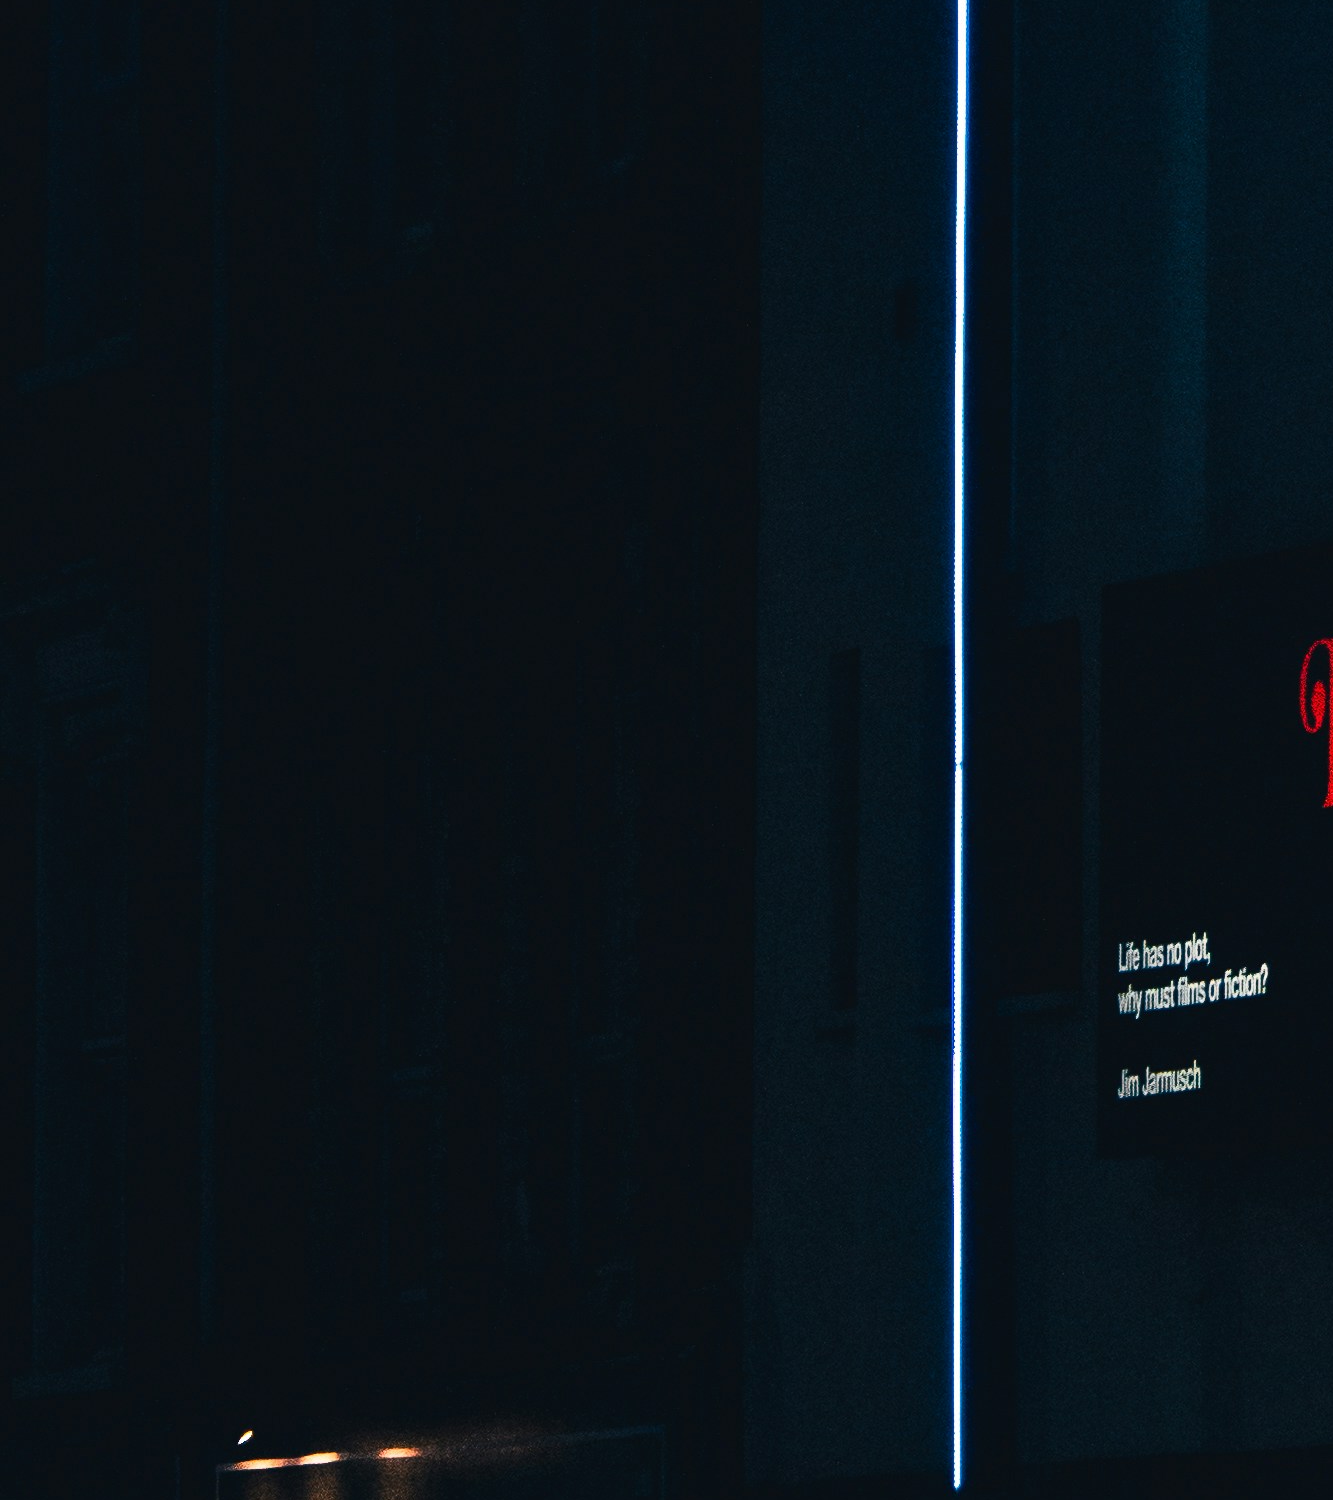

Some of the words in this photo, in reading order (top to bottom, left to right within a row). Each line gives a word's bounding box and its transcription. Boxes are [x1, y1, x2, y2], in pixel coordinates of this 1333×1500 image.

[1118, 940, 1141, 973] Life
[1142, 939, 1165, 969] has
[1166, 941, 1182, 966] no
[1184, 931, 1211, 971] plot,
[1117, 984, 1143, 1020] why
[1144, 980, 1176, 1012] must
[1176, 975, 1206, 1006] films
[1208, 977, 1223, 1003] or
[1223, 962, 1270, 1000] fiction?
[1117, 1067, 1140, 1099] Jim
[1142, 1059, 1202, 1097] Jarmusch
